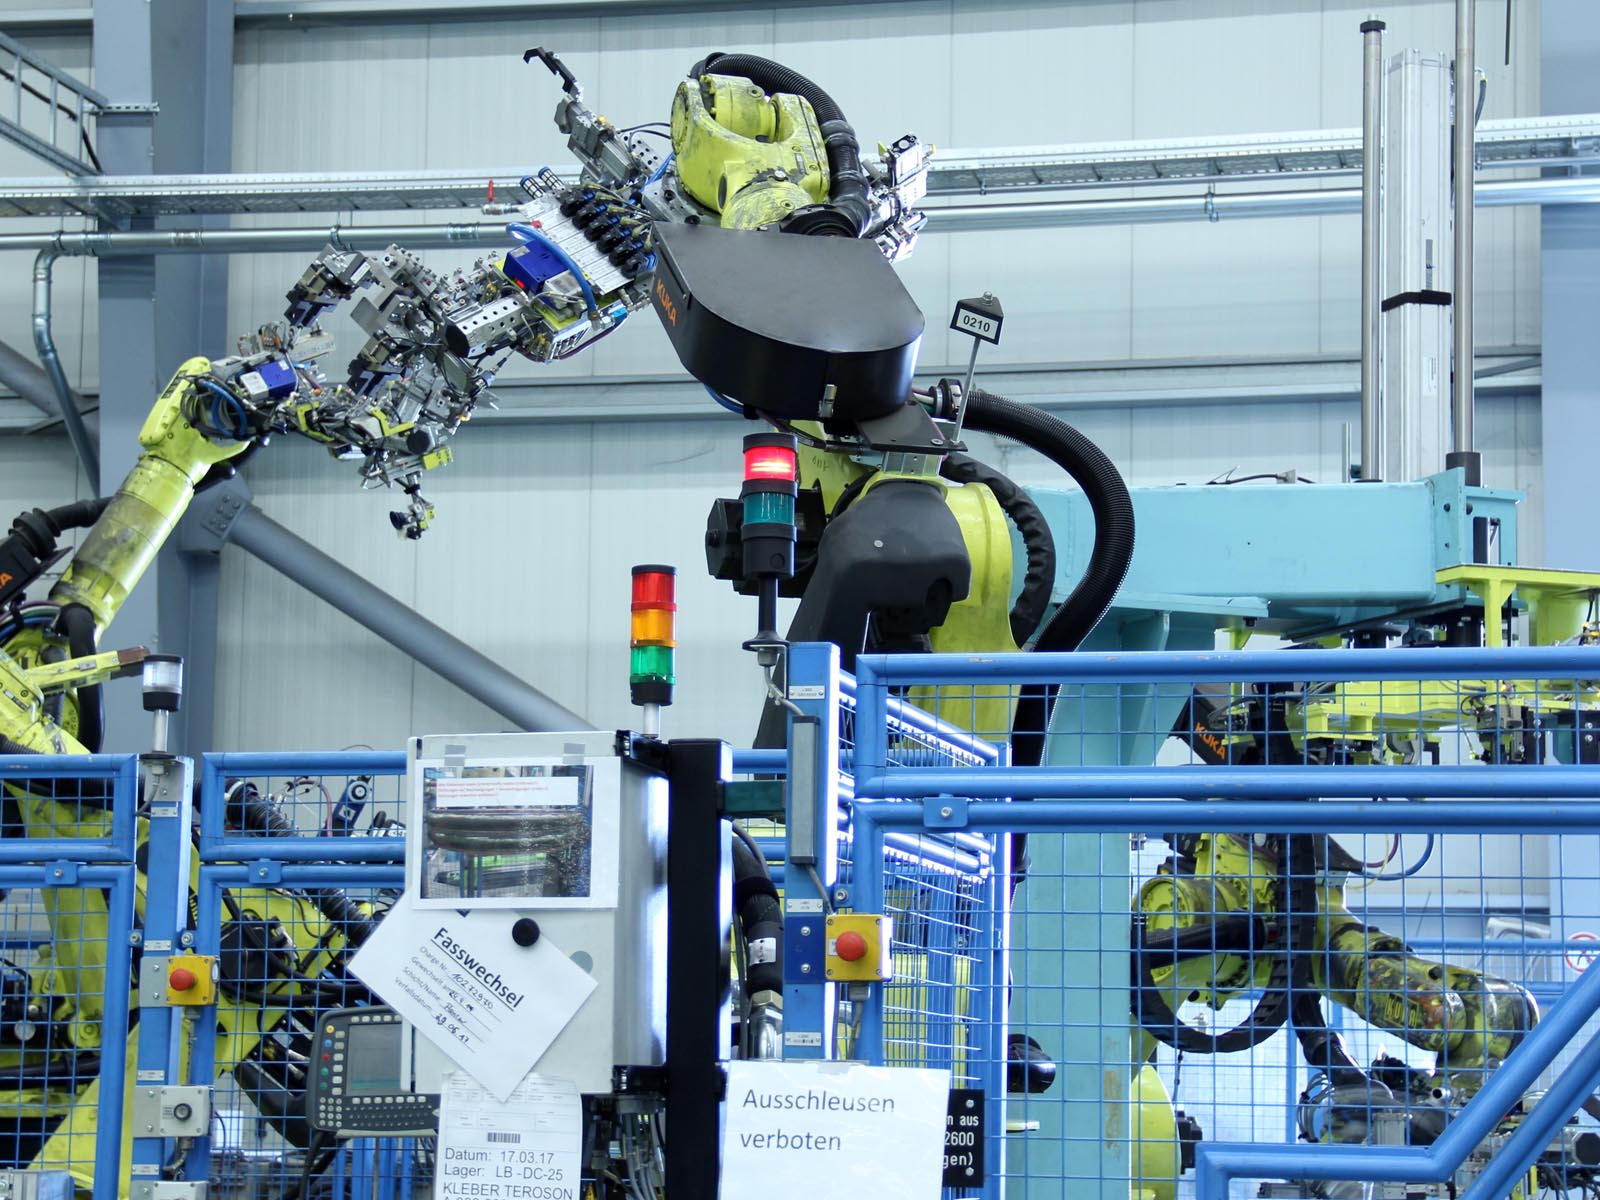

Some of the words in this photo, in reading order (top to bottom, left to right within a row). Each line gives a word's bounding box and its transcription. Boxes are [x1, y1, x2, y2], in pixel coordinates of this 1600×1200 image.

[656, 278, 676, 326] KUKA
[963, 315, 990, 332] 0210
[1195, 721, 1226, 760] KUKA
[434, 927, 524, 1009] Fasswechsel
[743, 1089, 895, 1113] Ausschleusen
[959, 1115, 979, 1126] aus
[740, 1128, 841, 1150] verboten
[944, 1131, 975, 1146] 2600
[445, 1147, 491, 1161] Datum:
[501, 1151, 554, 1165] 17.03.17
[444, 1163, 485, 1179] Lager:
[443, 1182, 500, 1196] KLEBER
[505, 1184, 573, 1199] TEROSON
